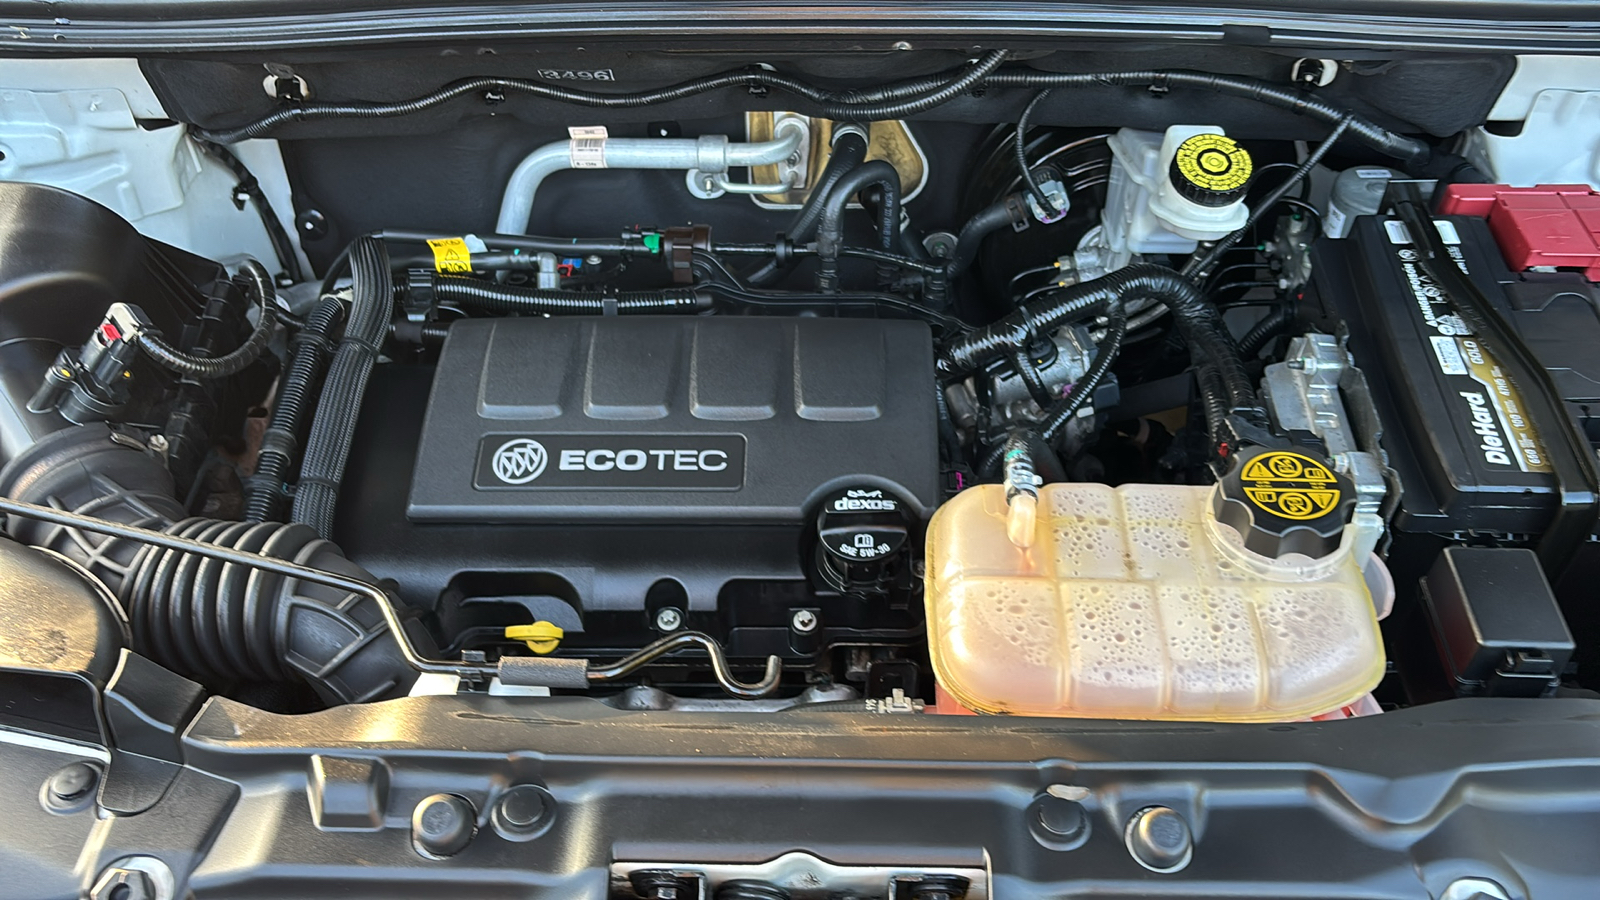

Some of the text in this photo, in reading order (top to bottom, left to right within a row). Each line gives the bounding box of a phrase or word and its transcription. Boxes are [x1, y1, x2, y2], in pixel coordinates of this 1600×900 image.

[543, 70, 610, 80] 3496
[1463, 340, 1484, 365] GOLD
[1459, 391, 1511, 465] DieHard
[559, 449, 728, 471] ECOTEC
[834, 497, 896, 510] dexos
[839, 543, 891, 558] SAE 5W-30
